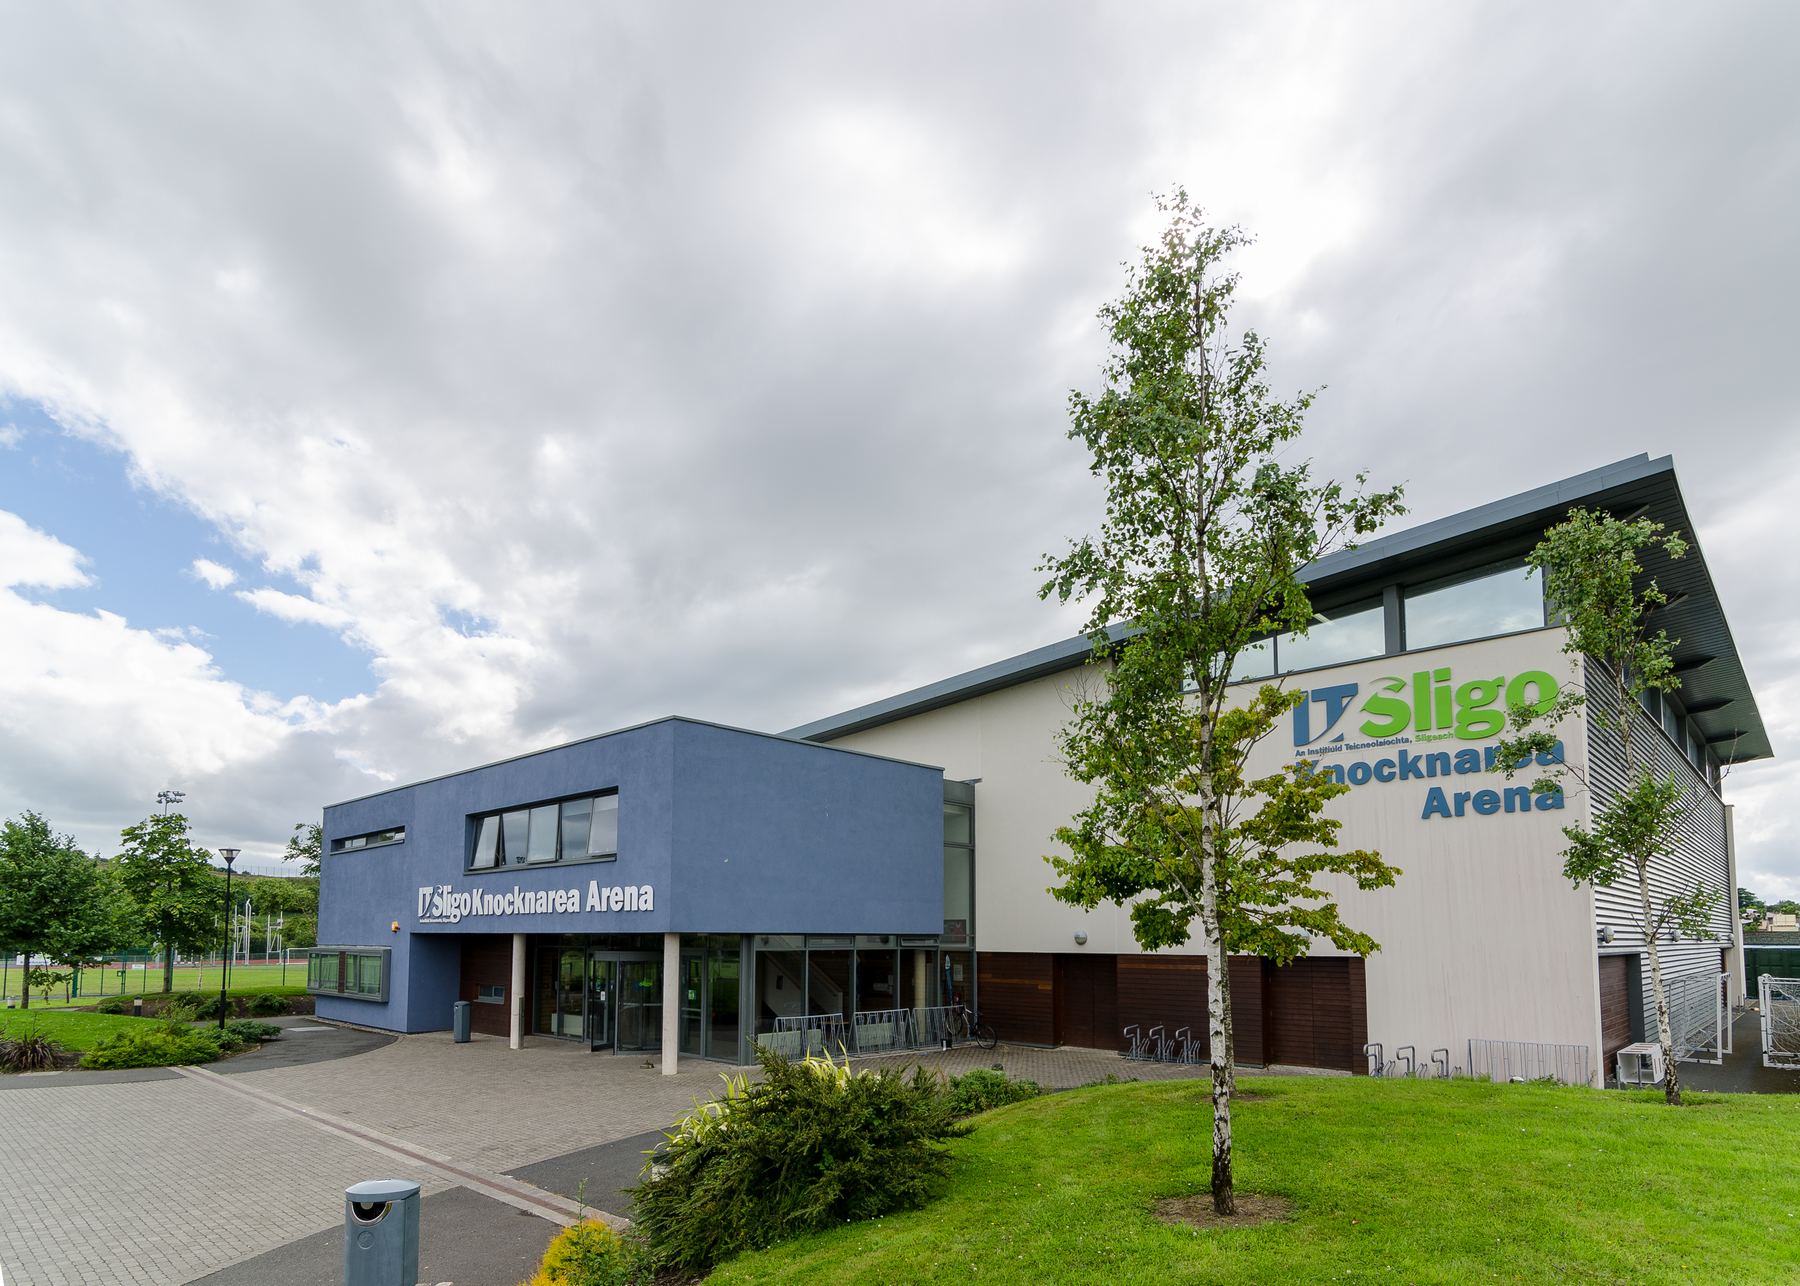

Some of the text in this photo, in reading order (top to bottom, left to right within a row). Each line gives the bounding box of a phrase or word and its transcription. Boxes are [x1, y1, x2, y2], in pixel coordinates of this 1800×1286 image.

[1359, 667, 1560, 740] Sligo
[1295, 749, 1306, 757] An
[1421, 784, 1565, 819] Arena
[432, 884, 472, 924] Sligo
[472, 885, 581, 916] Knocknarea
[586, 880, 654, 912] Arena
